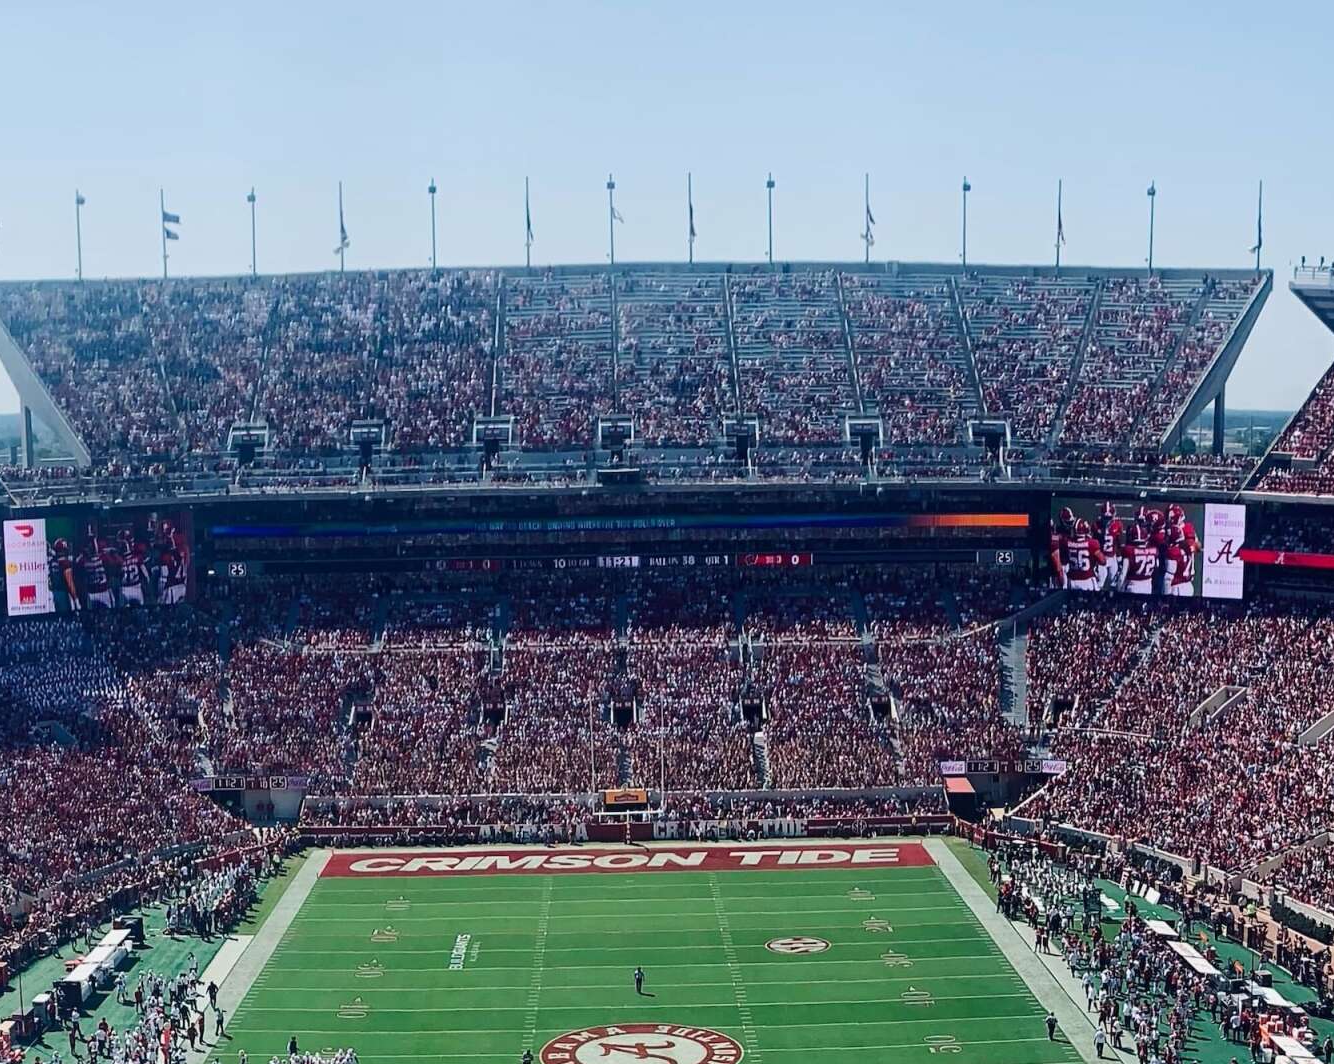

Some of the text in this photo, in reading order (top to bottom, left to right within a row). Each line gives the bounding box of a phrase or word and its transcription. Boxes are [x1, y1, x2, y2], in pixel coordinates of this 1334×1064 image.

[19, 561, 46, 571] Hiller
[553, 559, 566, 569] 10
[1135, 556, 1156, 576] 72
[231, 564, 244, 575] 25
[271, 778, 285, 788] 25
[349, 848, 900, 874] CRIMSON TIDE
